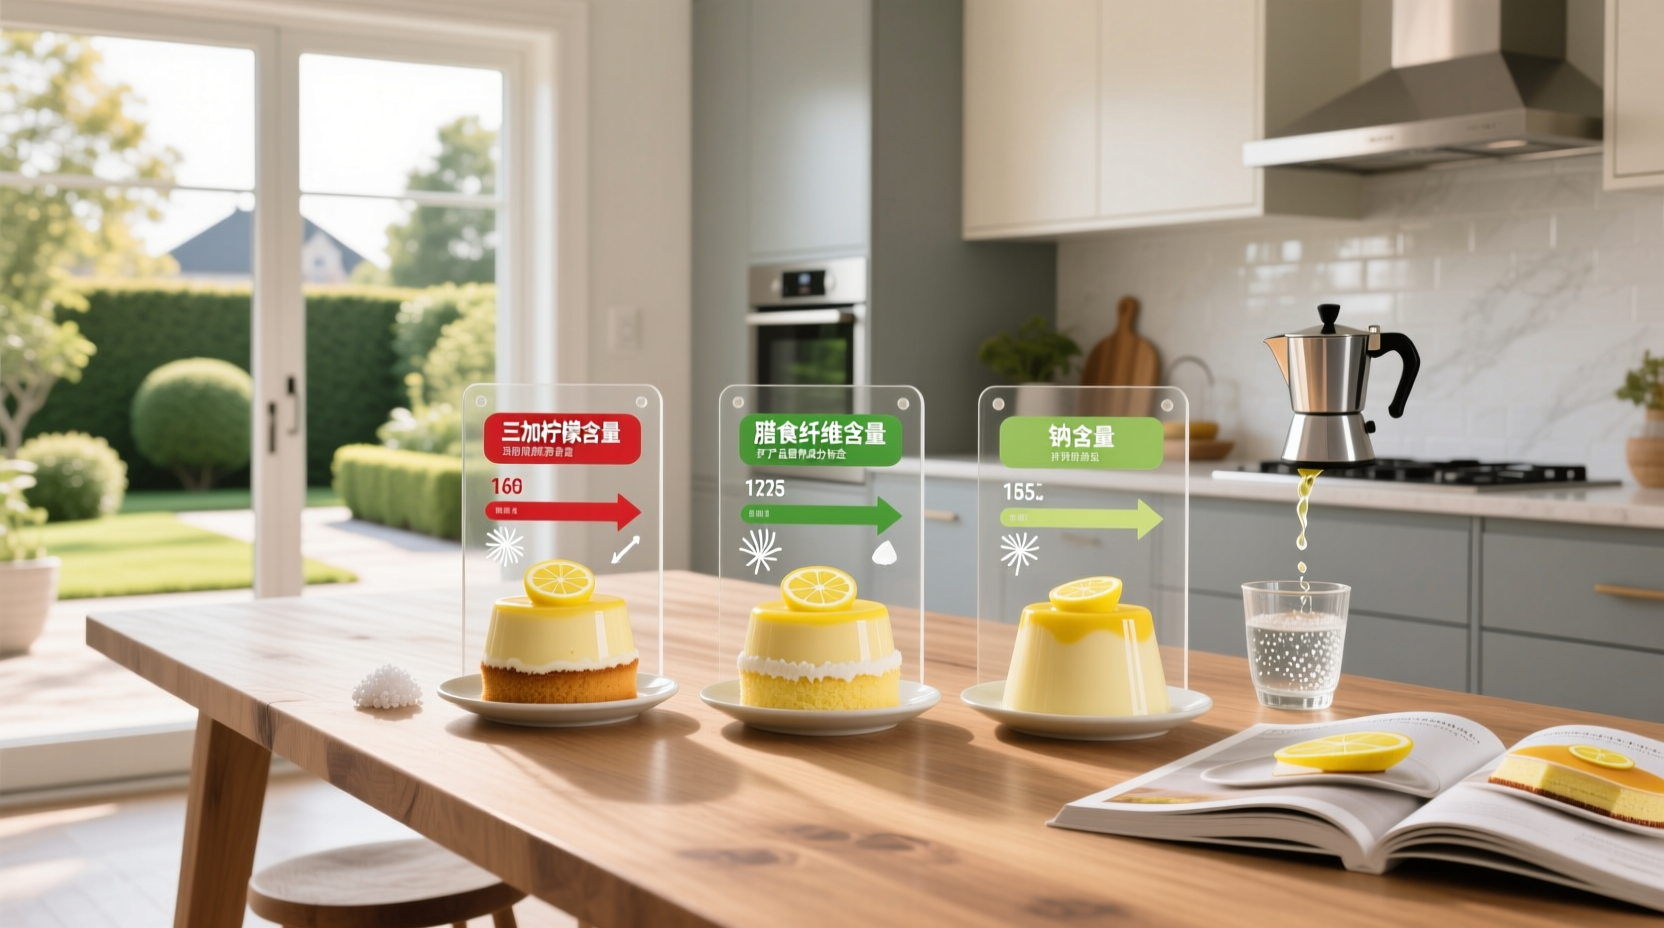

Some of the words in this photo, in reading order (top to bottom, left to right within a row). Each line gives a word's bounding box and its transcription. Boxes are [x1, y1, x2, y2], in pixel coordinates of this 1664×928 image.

[754, 420, 885, 445] 膳食纤维含量
[1049, 423, 1115, 447] 钠含量
[745, 479, 784, 497] 1225
